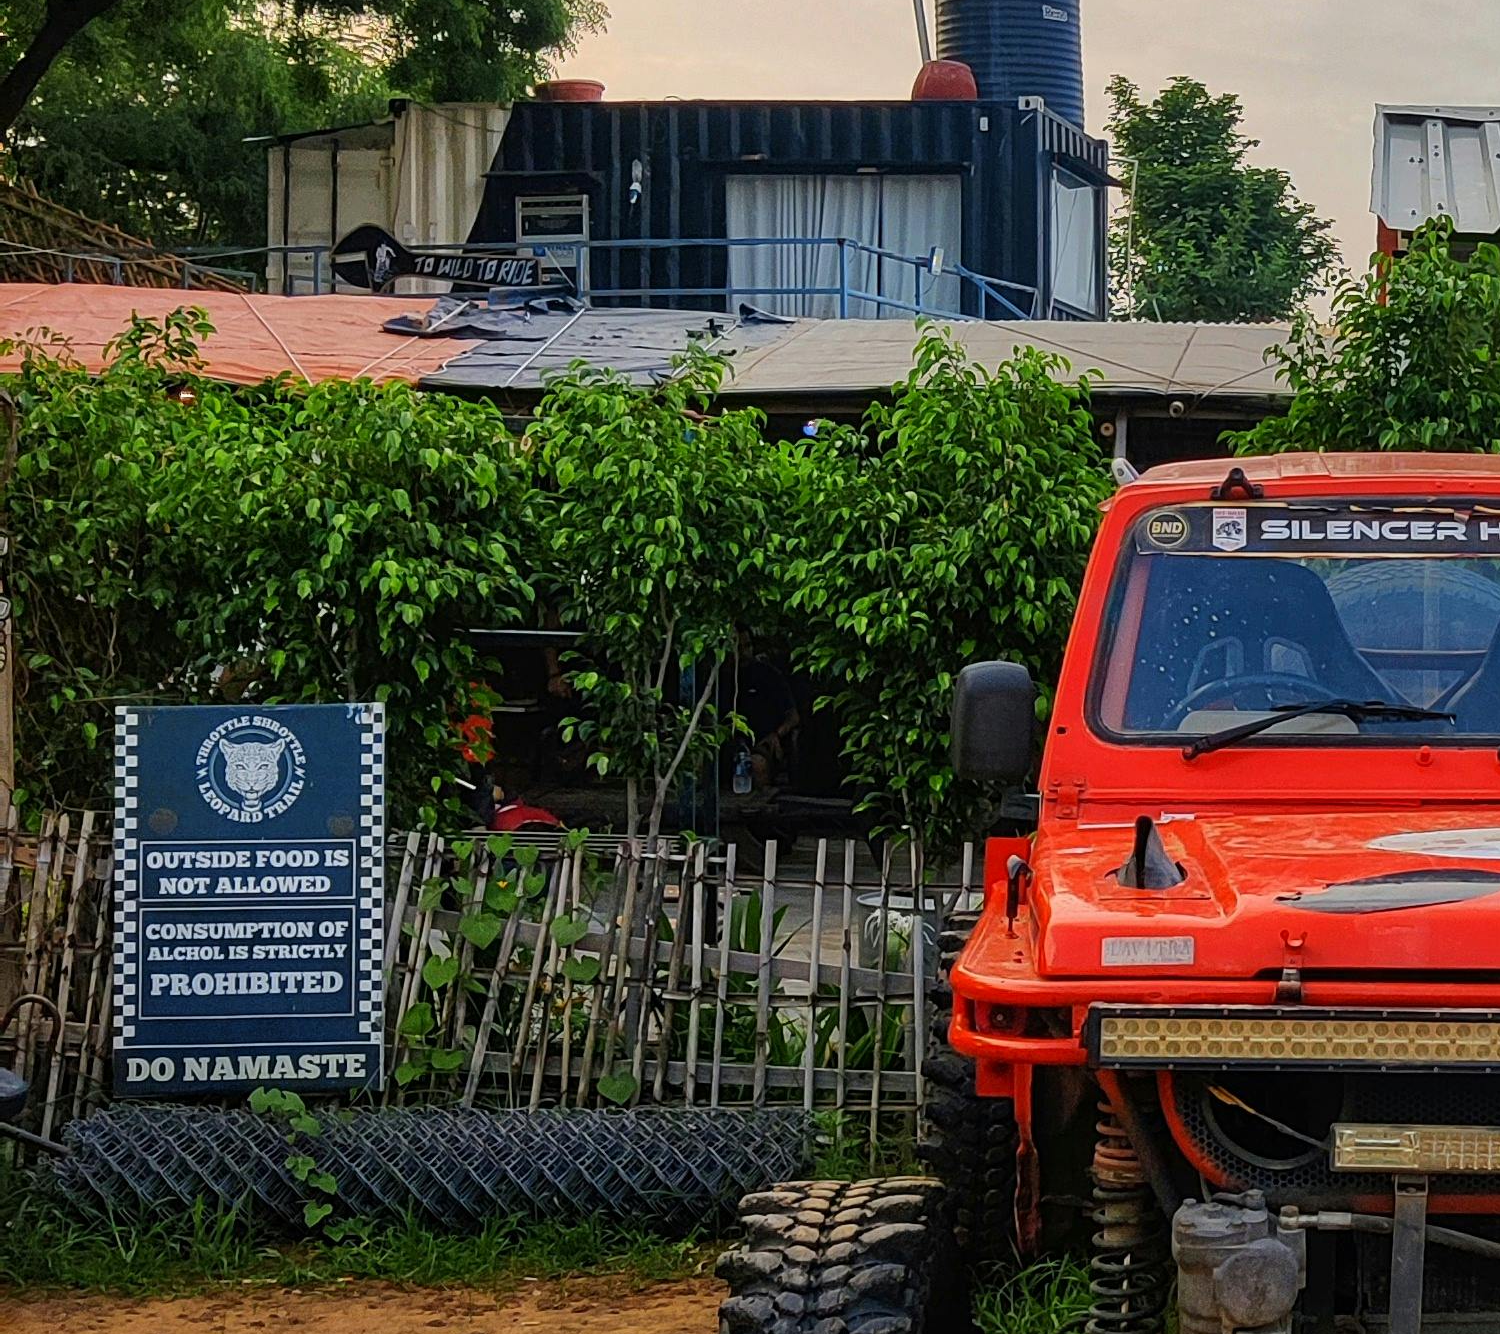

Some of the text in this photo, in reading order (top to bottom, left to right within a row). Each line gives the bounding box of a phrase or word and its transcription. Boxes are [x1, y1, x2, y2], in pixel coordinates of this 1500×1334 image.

[437, 258, 473, 279] WILD
[497, 259, 537, 285] RIDE
[1151, 521, 1183, 534] BND
[1260, 520, 1468, 540] SILENCER
[196, 716, 306, 765] THROTTLE SHROTTLE
[199, 780, 304, 823] LEOPARD TRAIL
[146, 849, 349, 869] OUTSIDE FOOD IS
[159, 876, 331, 895] NOT ALLOWED
[146, 921, 349, 940] CONSUMPTION OF
[147, 943, 347, 961] ALCHOL IS STRICTLY
[150, 971, 344, 996] PROHIBITED
[126, 1054, 366, 1082] DO NAMASTE
